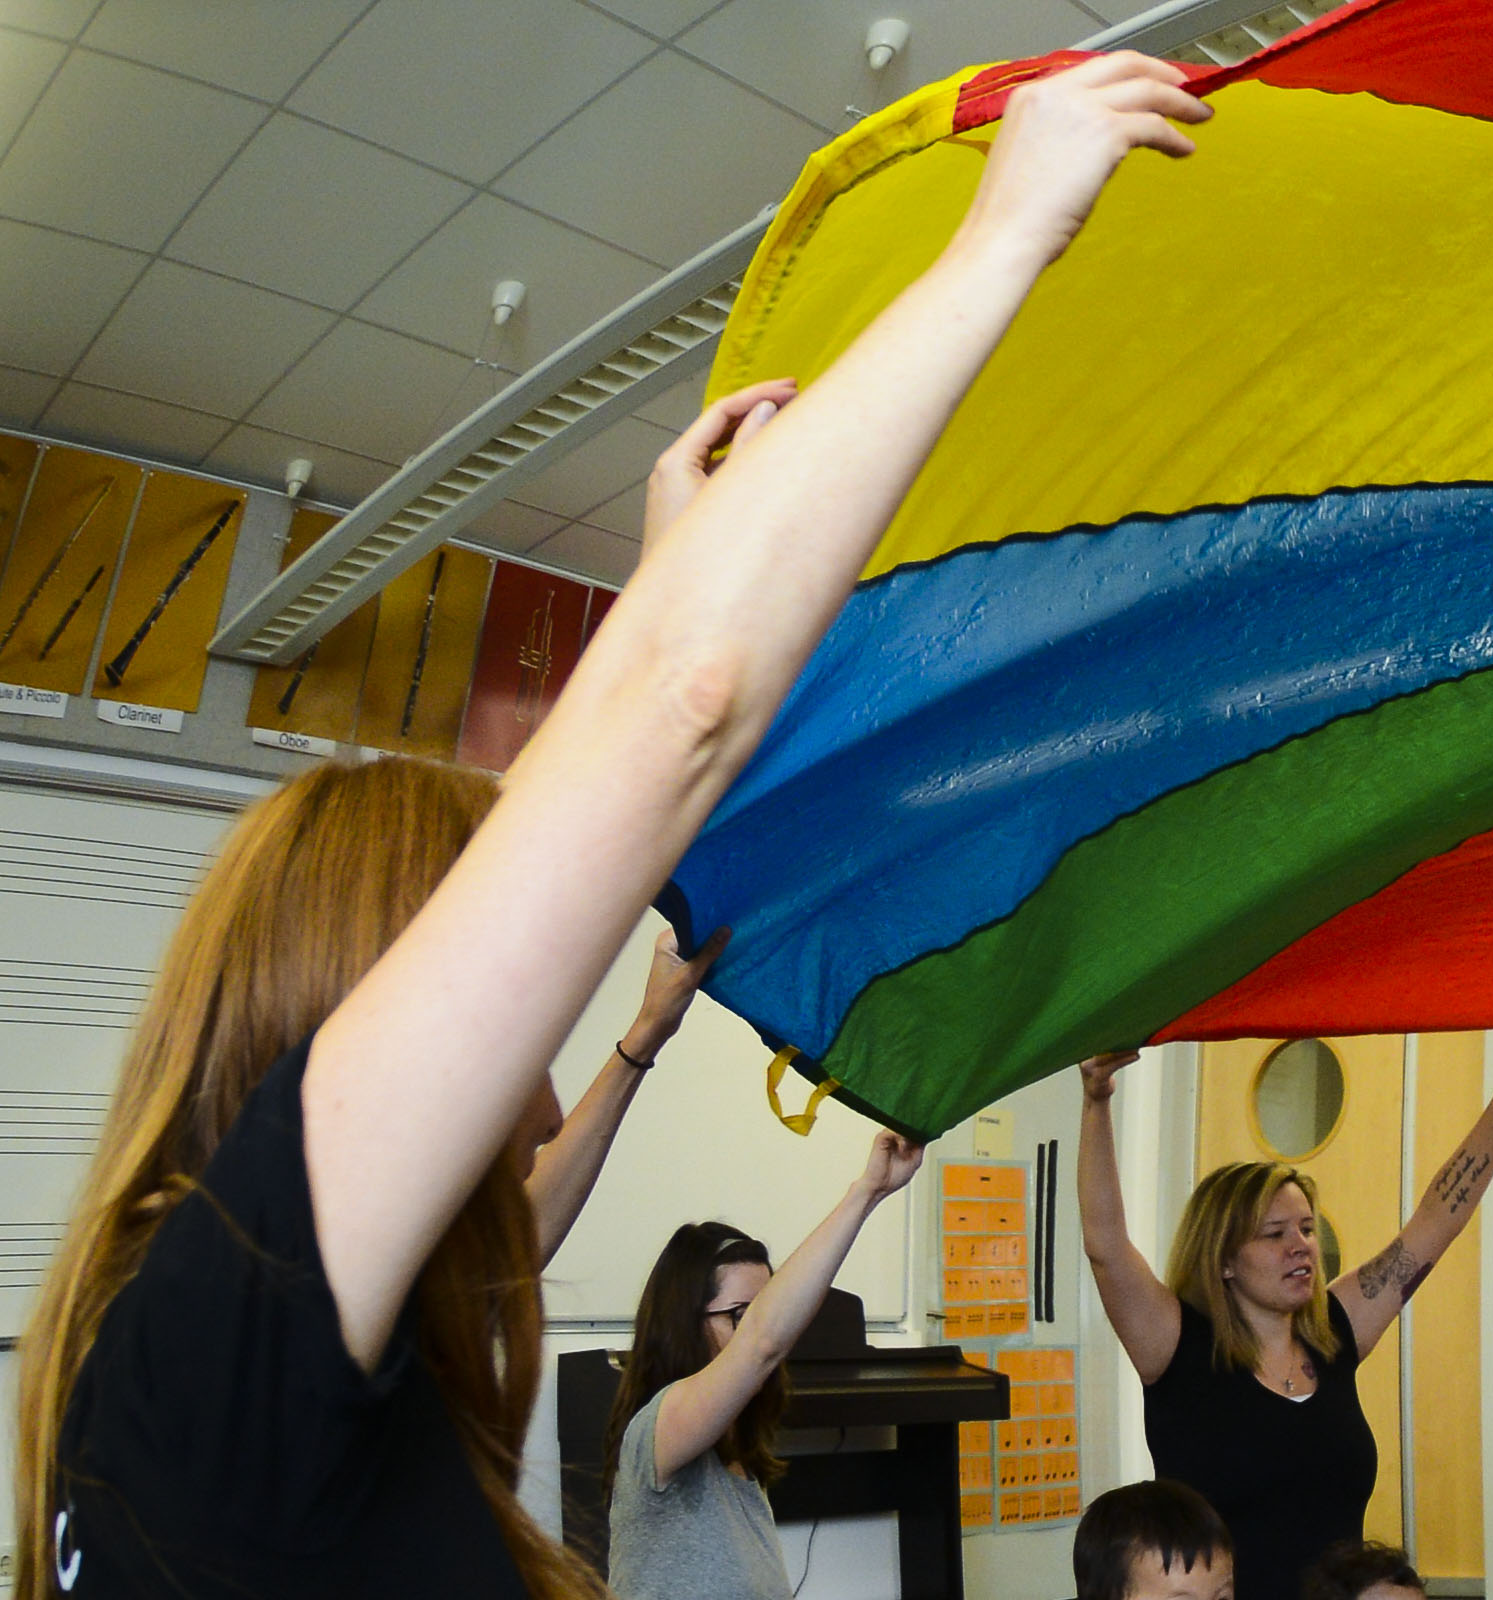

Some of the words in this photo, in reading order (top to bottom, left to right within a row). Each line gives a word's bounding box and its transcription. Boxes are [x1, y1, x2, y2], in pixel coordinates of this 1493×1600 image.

[16, 687, 23, 700] &
[27, 689, 61, 703] Piccolo
[118, 704, 163, 725] Clarinet
[279, 732, 310, 749] Oboe
